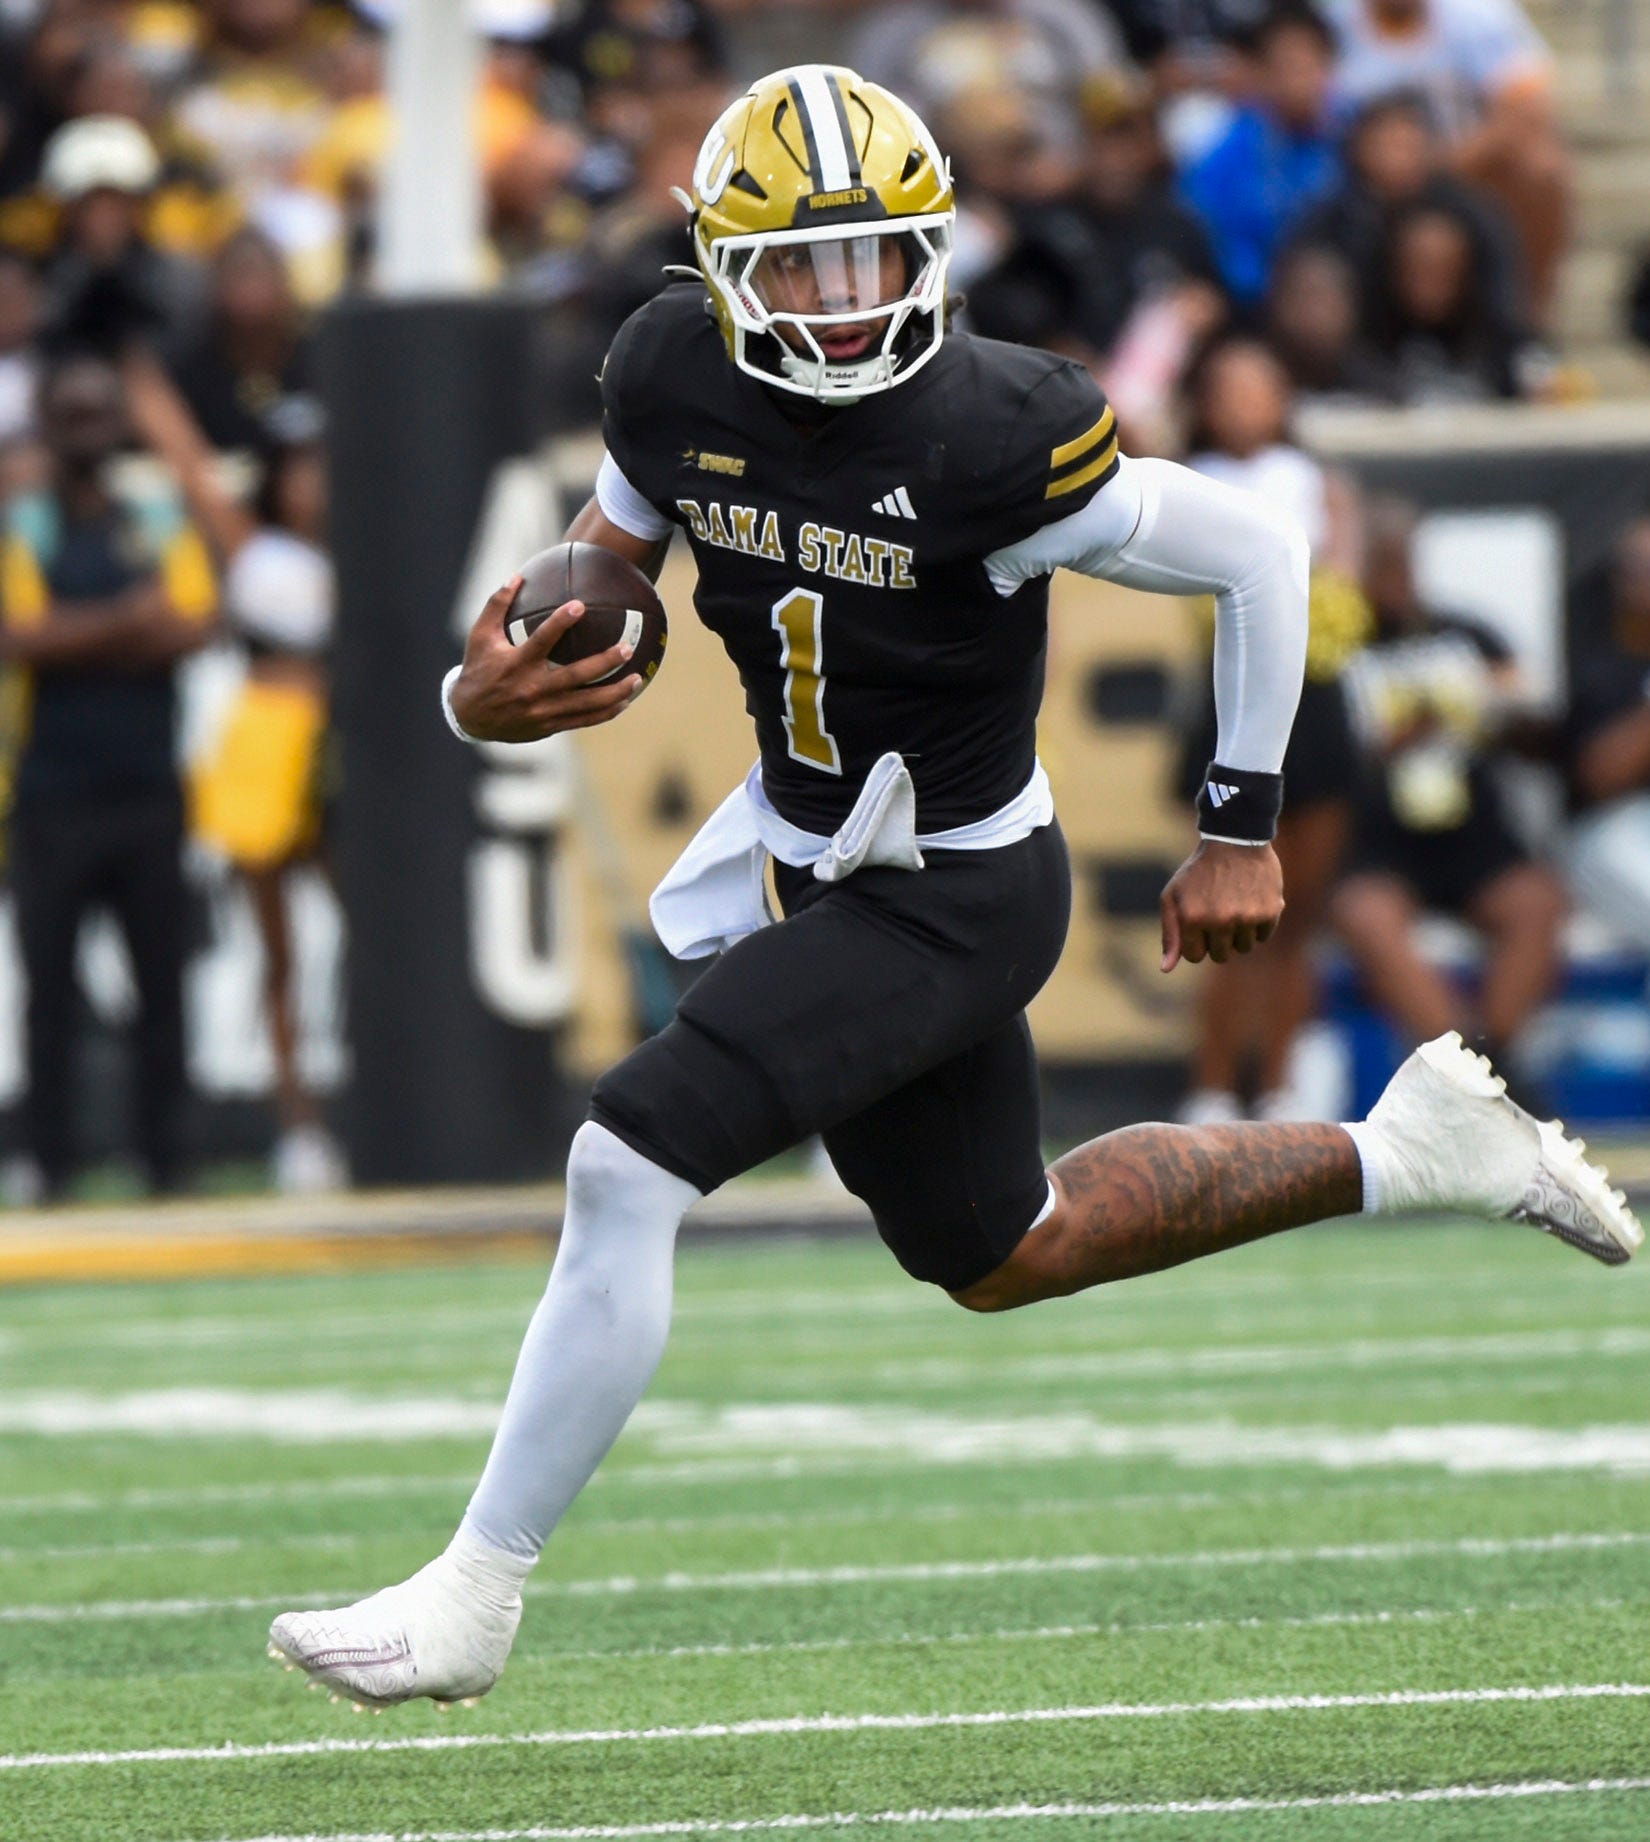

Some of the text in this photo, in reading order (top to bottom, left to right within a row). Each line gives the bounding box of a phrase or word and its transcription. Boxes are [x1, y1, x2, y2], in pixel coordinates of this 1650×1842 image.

[809, 188, 868, 210] HORNETS
[825, 371, 859, 379] Riddell
[697, 452, 745, 477] SWAC
[798, 522, 917, 589] STATE
[771, 586, 843, 776] 1
